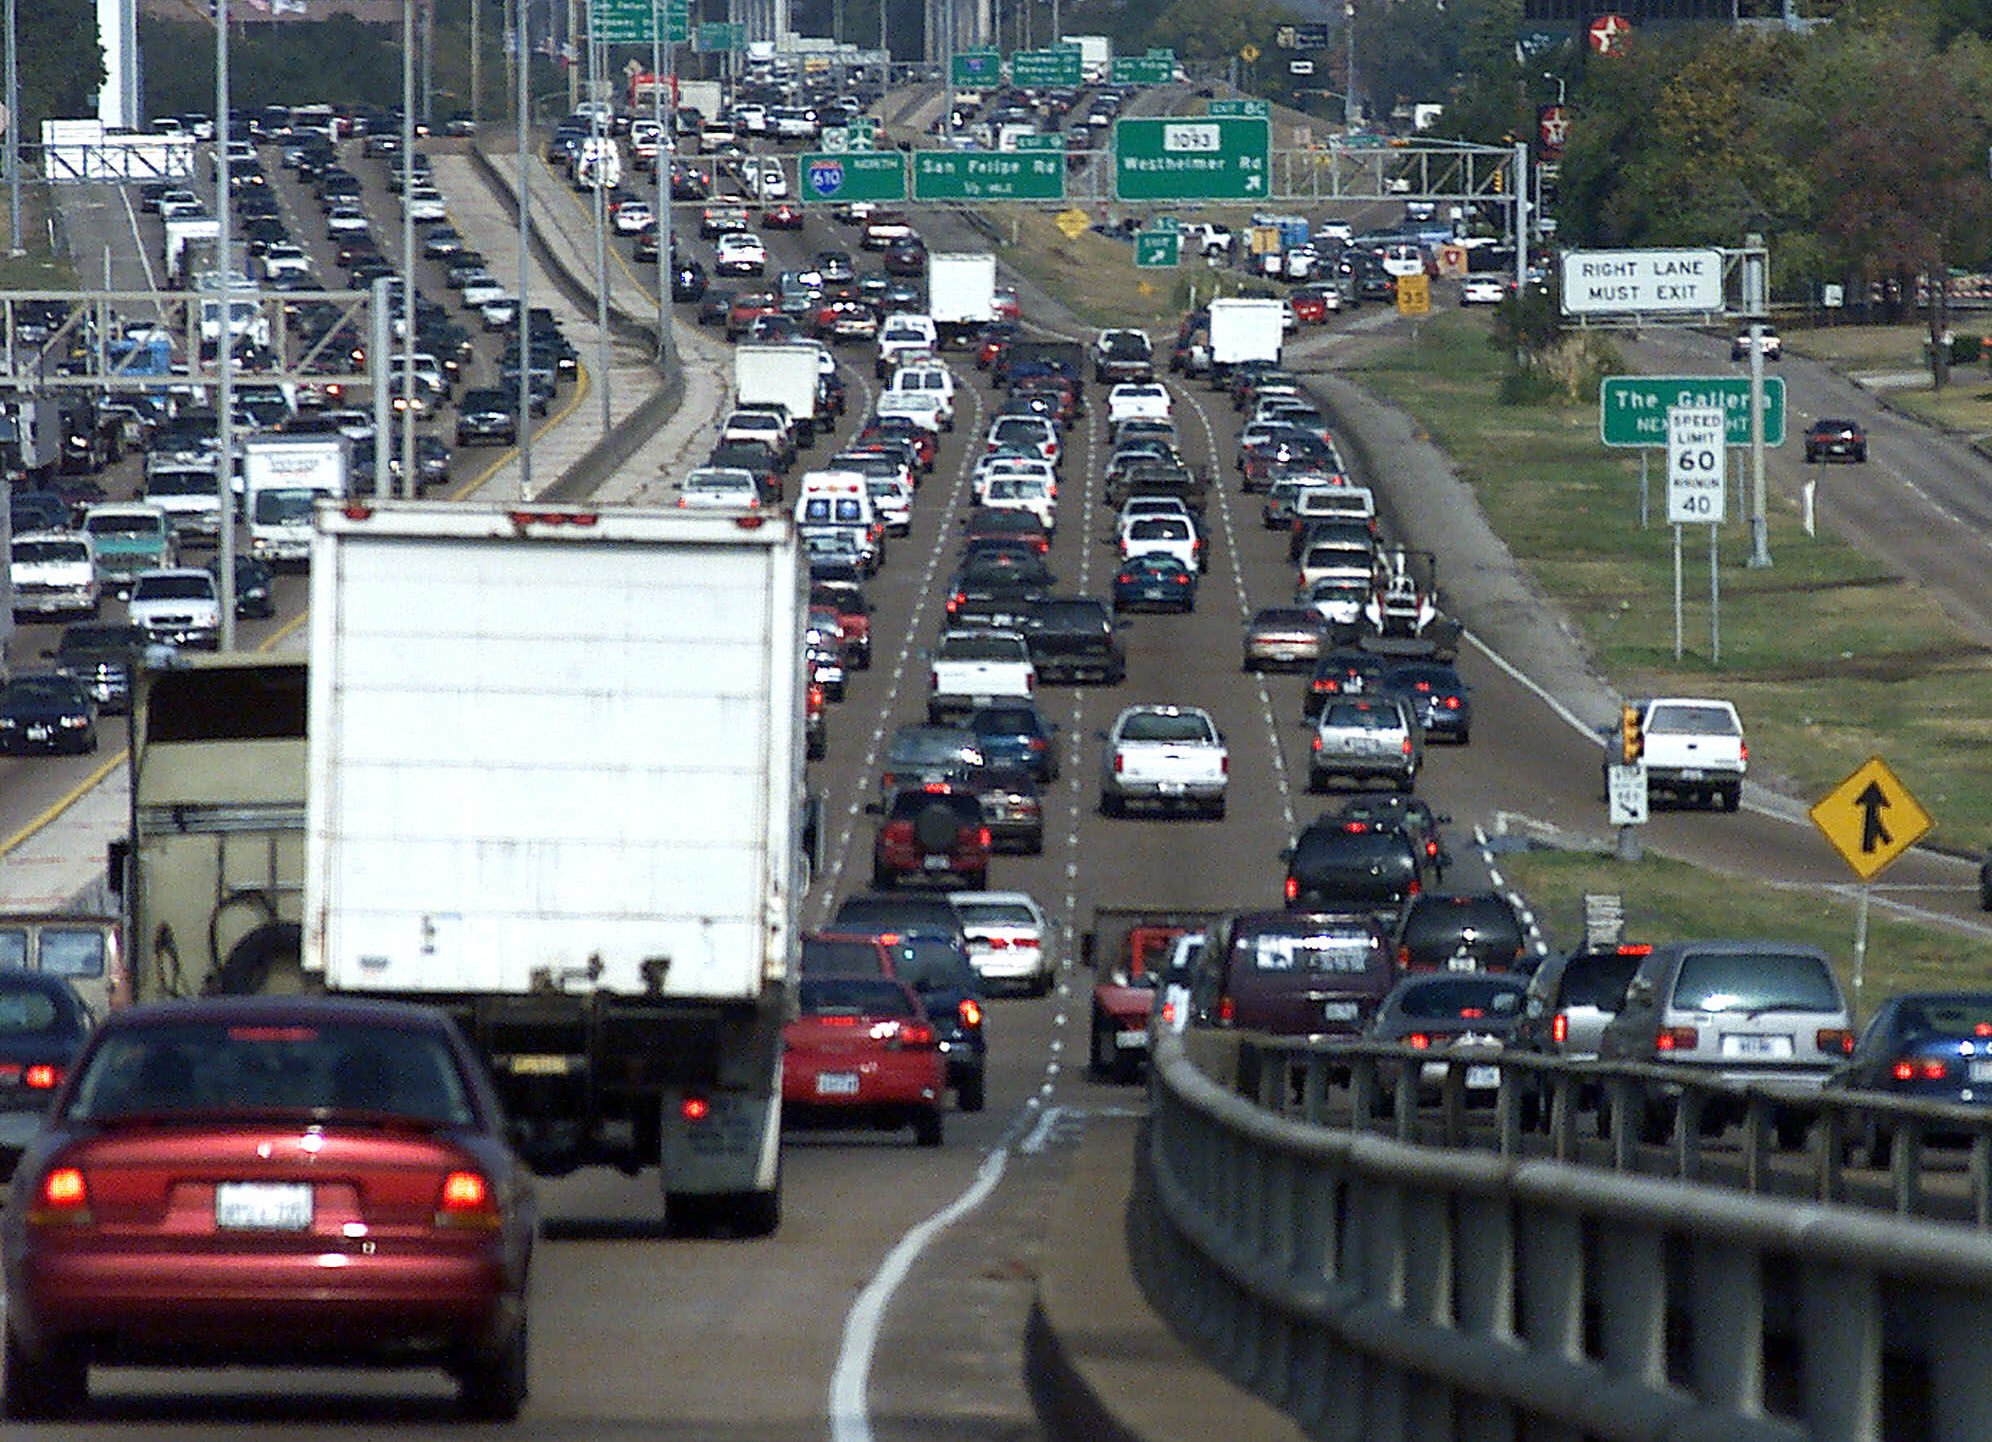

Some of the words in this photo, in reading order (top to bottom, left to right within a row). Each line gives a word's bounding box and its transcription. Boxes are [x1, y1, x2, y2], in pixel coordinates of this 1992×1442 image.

[1172, 132, 1211, 148] 1093
[921, 159, 956, 174] San
[967, 159, 1020, 175] Felipe
[1032, 160, 1056, 174] Rd
[1123, 156, 1226, 171] Westheimer
[1238, 155, 1262, 170] Rd
[813, 170, 841, 185] 610
[1582, 262, 1638, 277] RIGHT
[1653, 261, 1704, 277] LANE
[1588, 285, 1641, 301] MUST
[1656, 284, 1698, 300] EXIT
[1615, 390, 1659, 410] The
[1677, 390, 1773, 410] Gallera
[1673, 415, 1721, 427] SPEED
[1678, 432, 1715, 445] LIMIT
[1679, 450, 1716, 471] 60
[1682, 496, 1711, 514] 40
